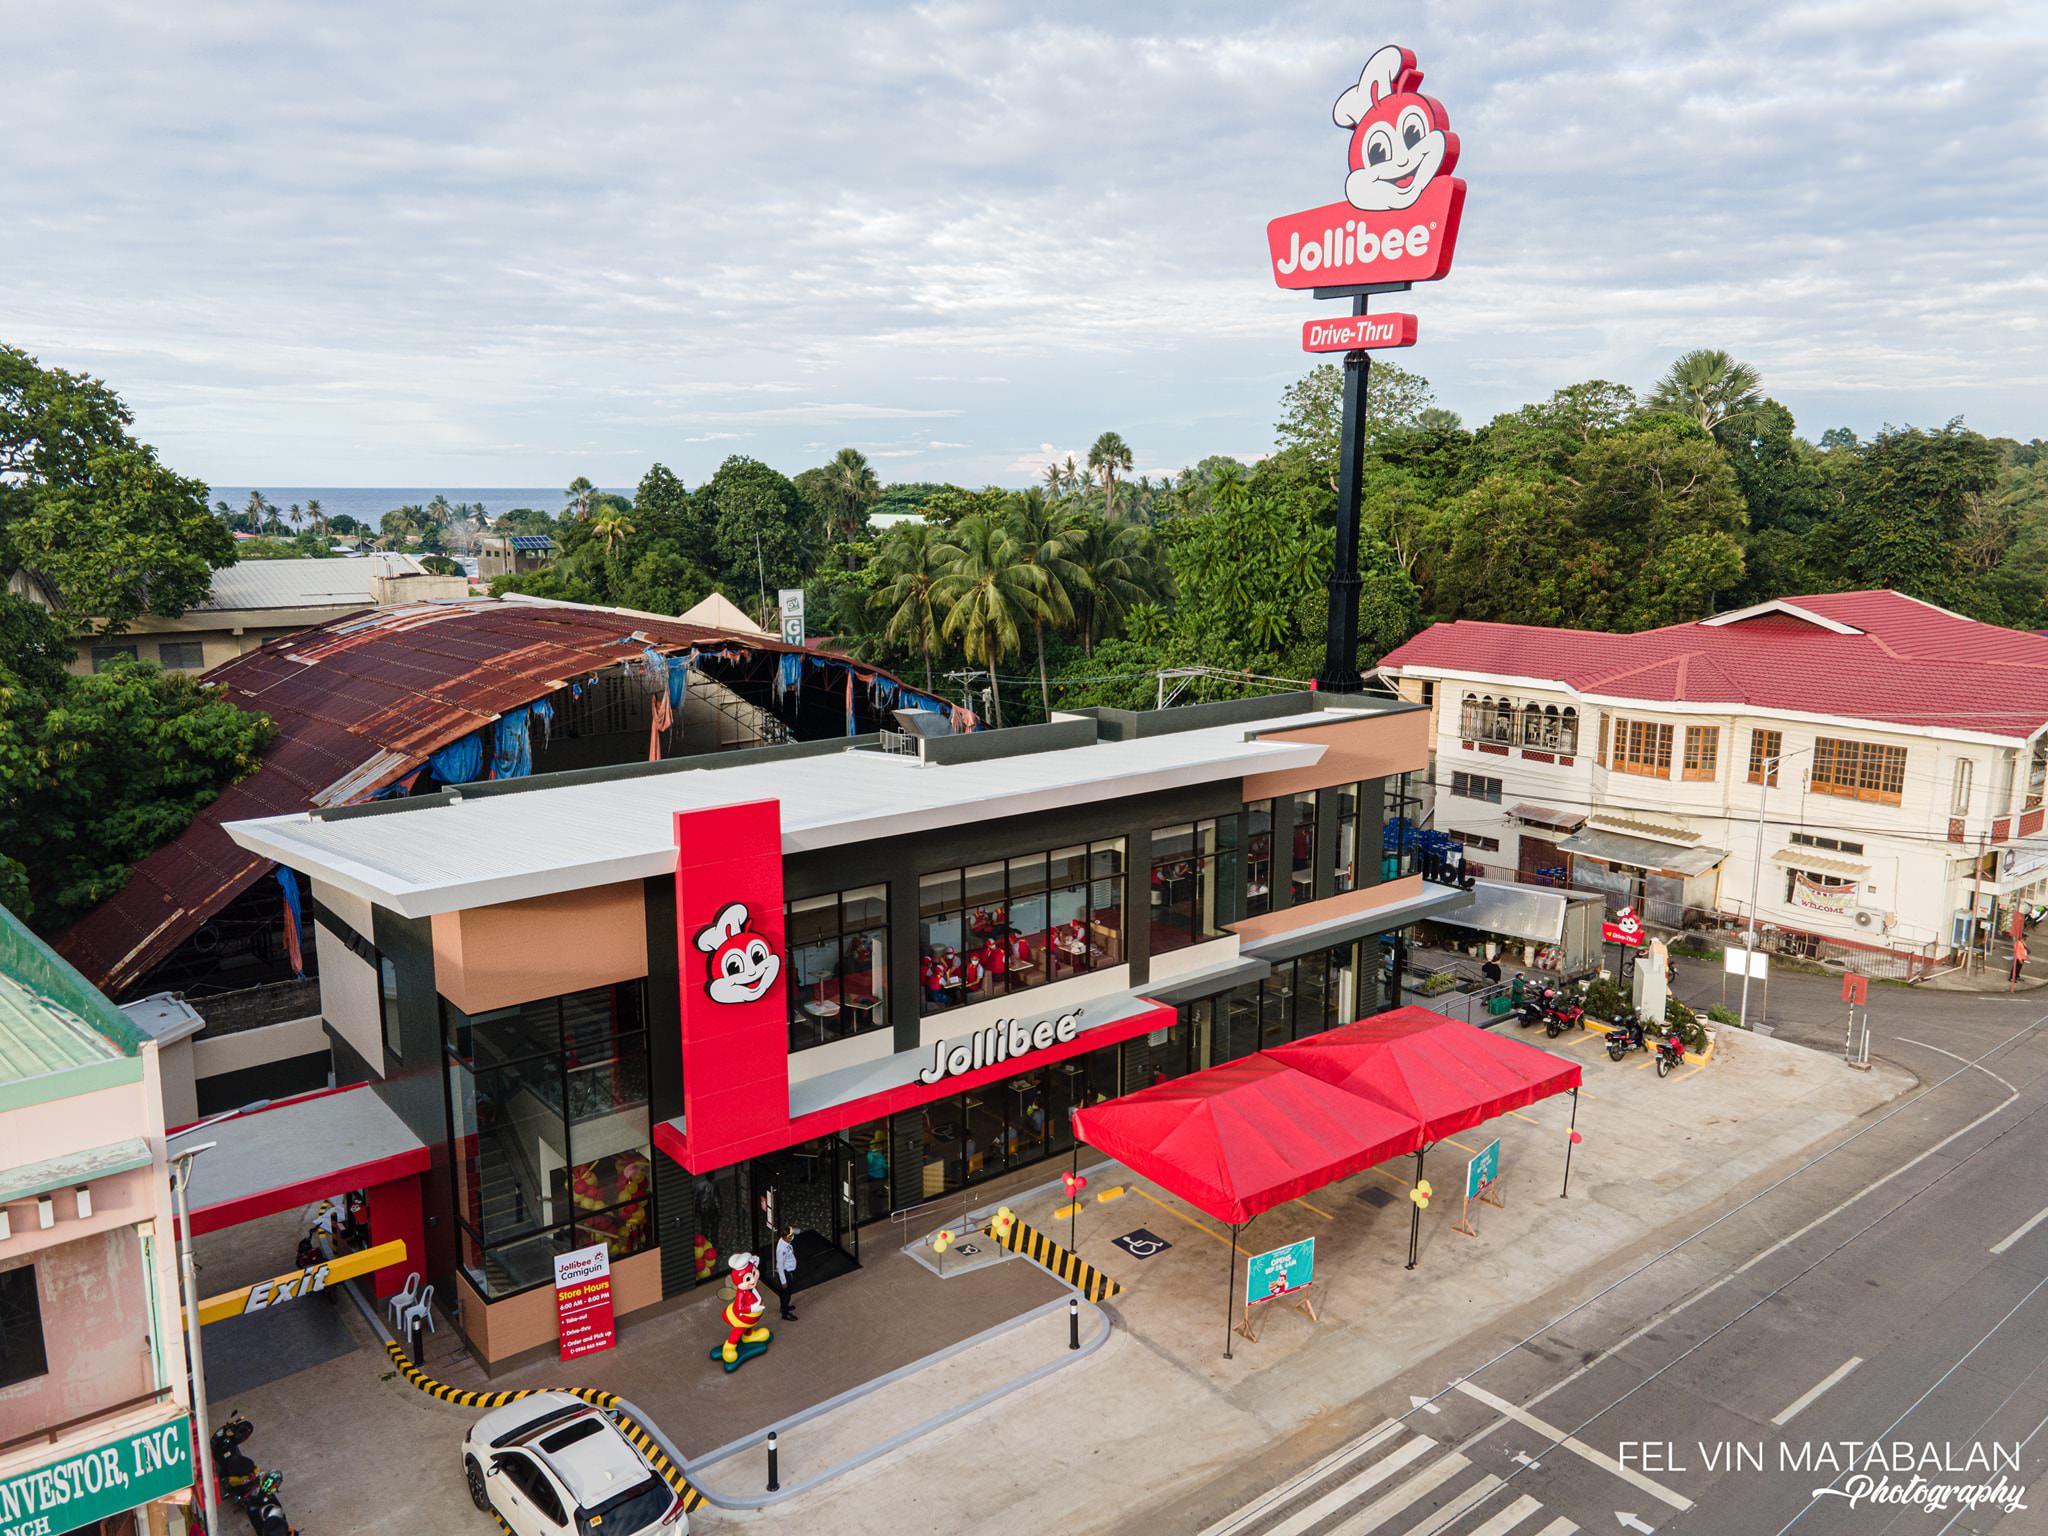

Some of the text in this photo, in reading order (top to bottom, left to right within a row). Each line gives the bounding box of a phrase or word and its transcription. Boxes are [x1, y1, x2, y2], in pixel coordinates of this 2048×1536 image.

[1277, 220, 1430, 274] Jollibee
[1309, 321, 1394, 346] Drive-Thru
[1801, 899, 1844, 914] WELCOME
[920, 1014, 1077, 1084] Jollibee
[559, 1259, 592, 1273] Jollibee
[561, 1264, 602, 1281] Camiguin
[243, 1264, 330, 1314] Exit
[559, 1281, 609, 1301] Store Hours
[573, 1299, 583, 1307] AM
[600, 1291, 610, 1299] PM
[0, 1425, 186, 1524] NVESTOR, INC.
